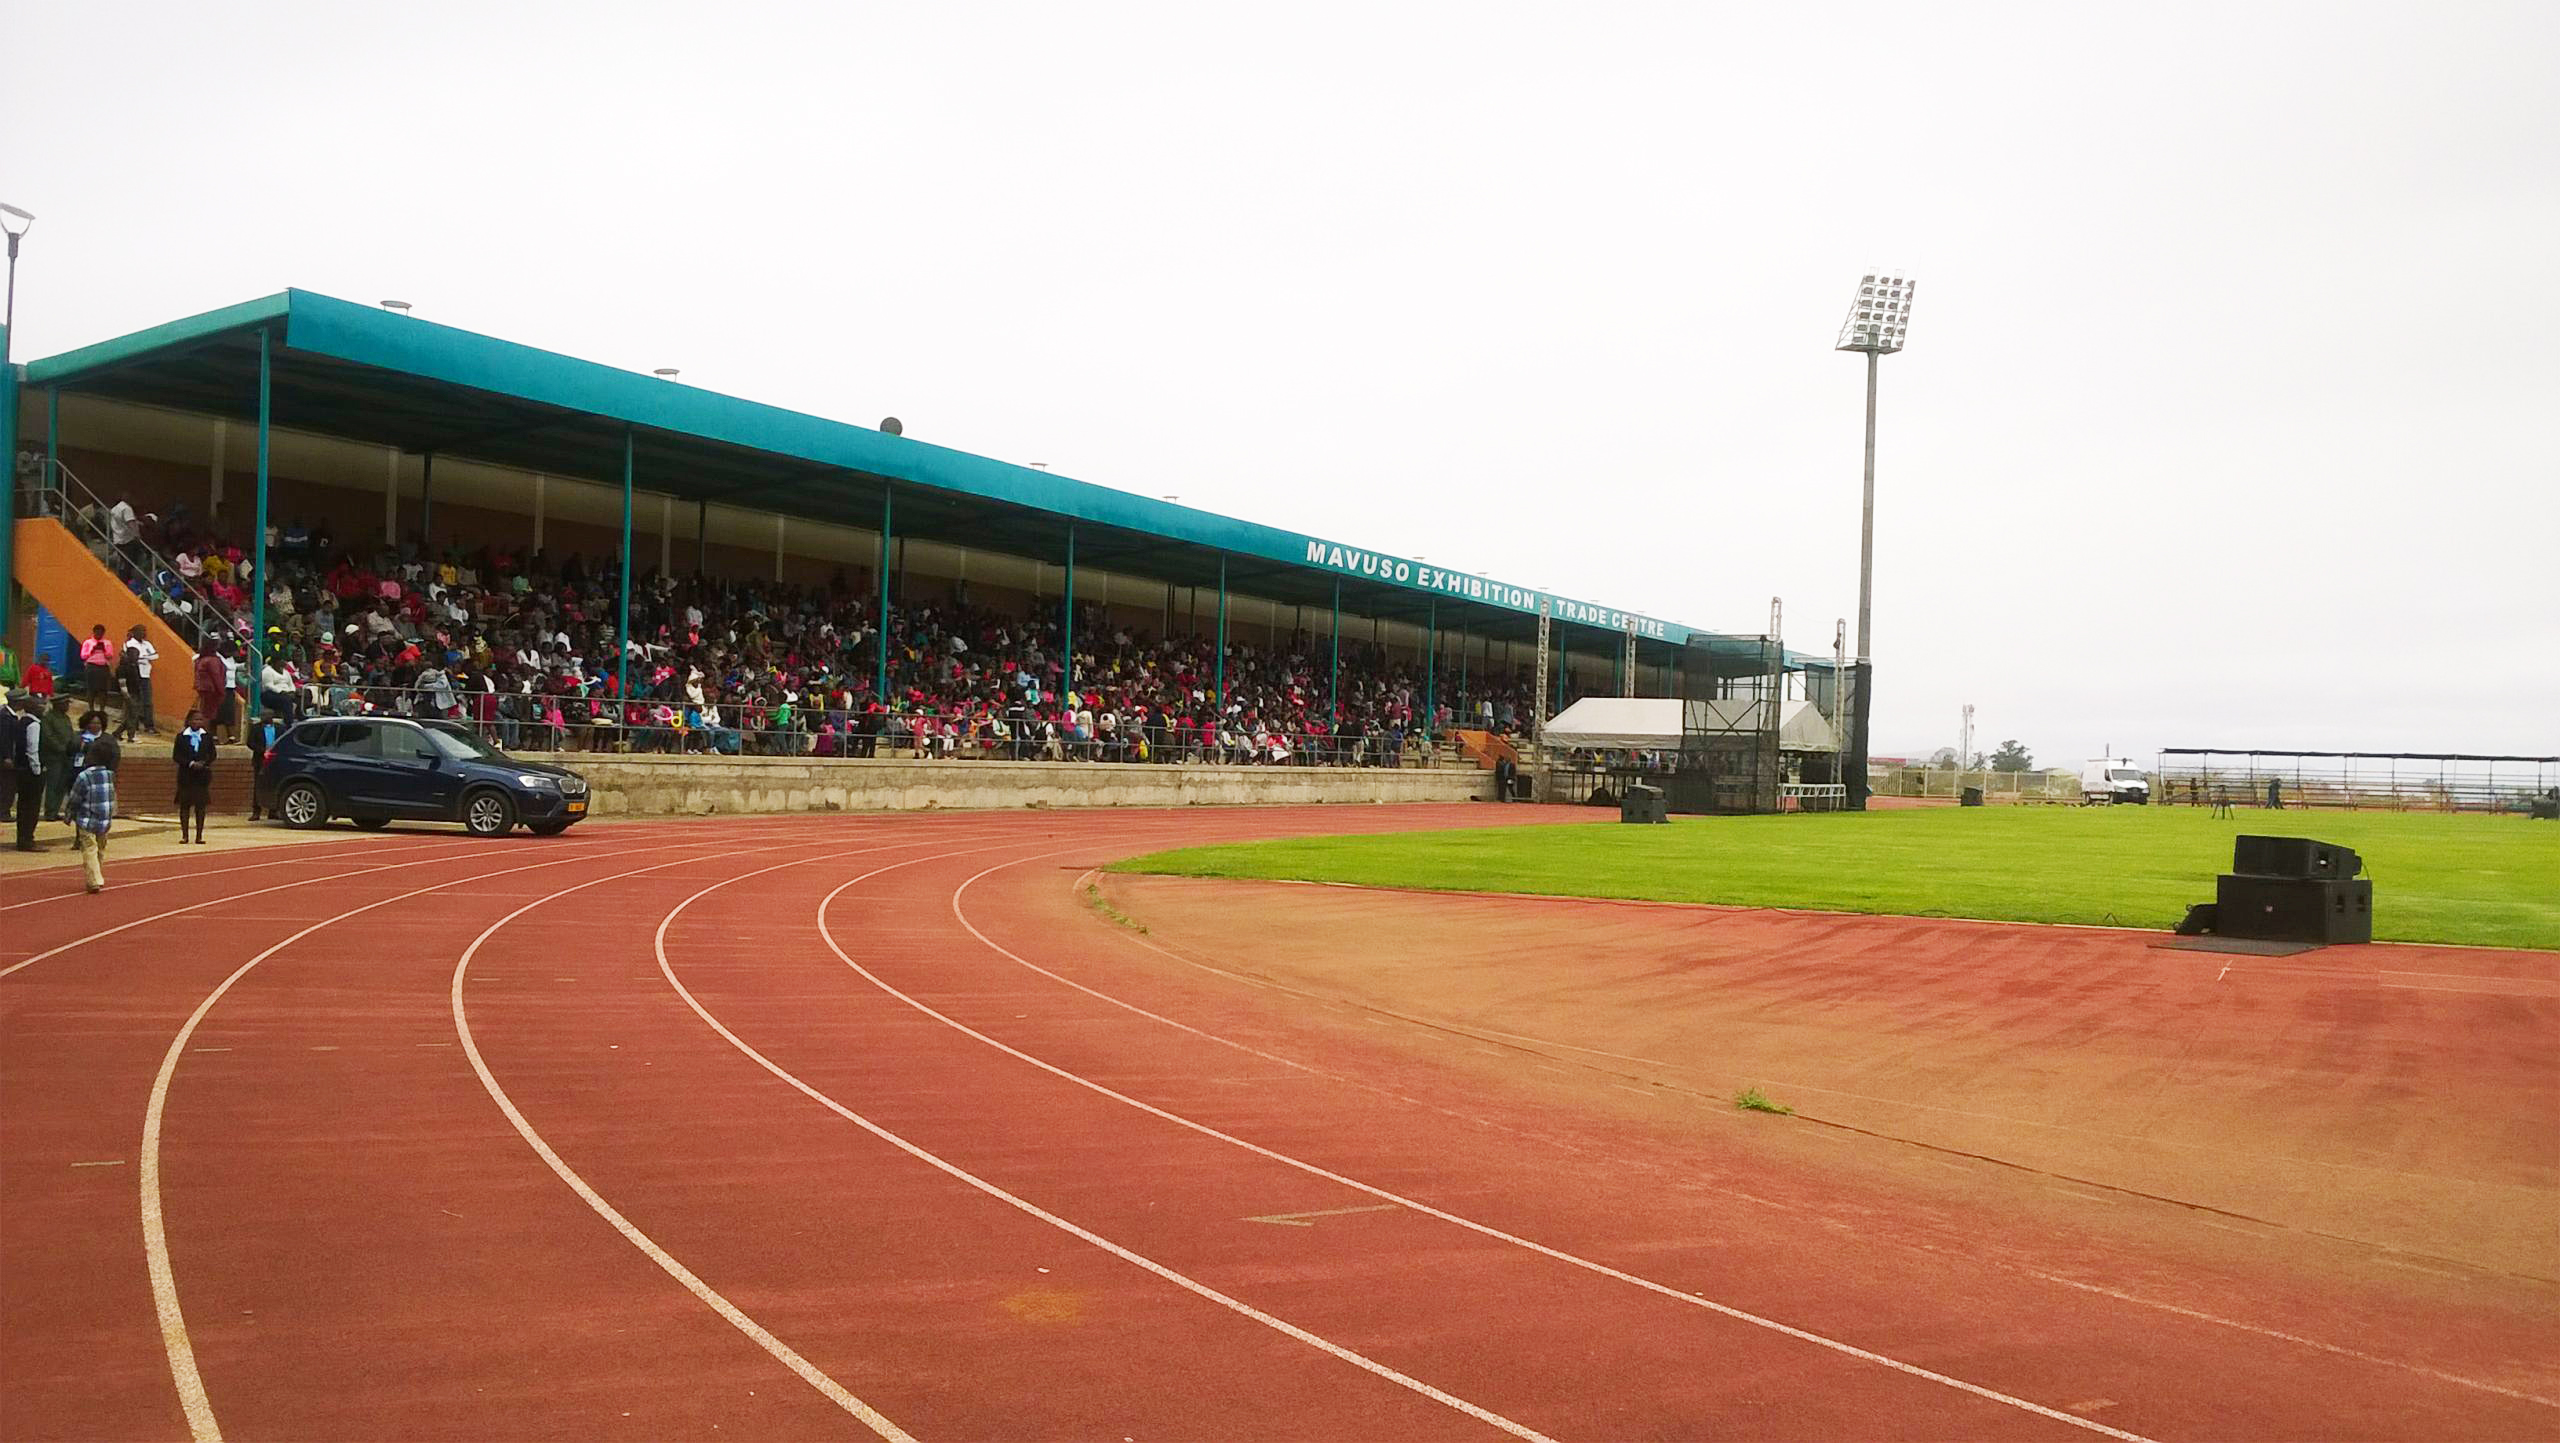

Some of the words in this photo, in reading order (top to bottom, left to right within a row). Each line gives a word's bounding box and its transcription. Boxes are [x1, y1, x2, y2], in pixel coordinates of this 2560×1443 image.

[1306, 541, 1410, 582] MAVUSO
[1417, 567, 1535, 609] EXHIBITION
[1556, 599, 1607, 625] TRADE
